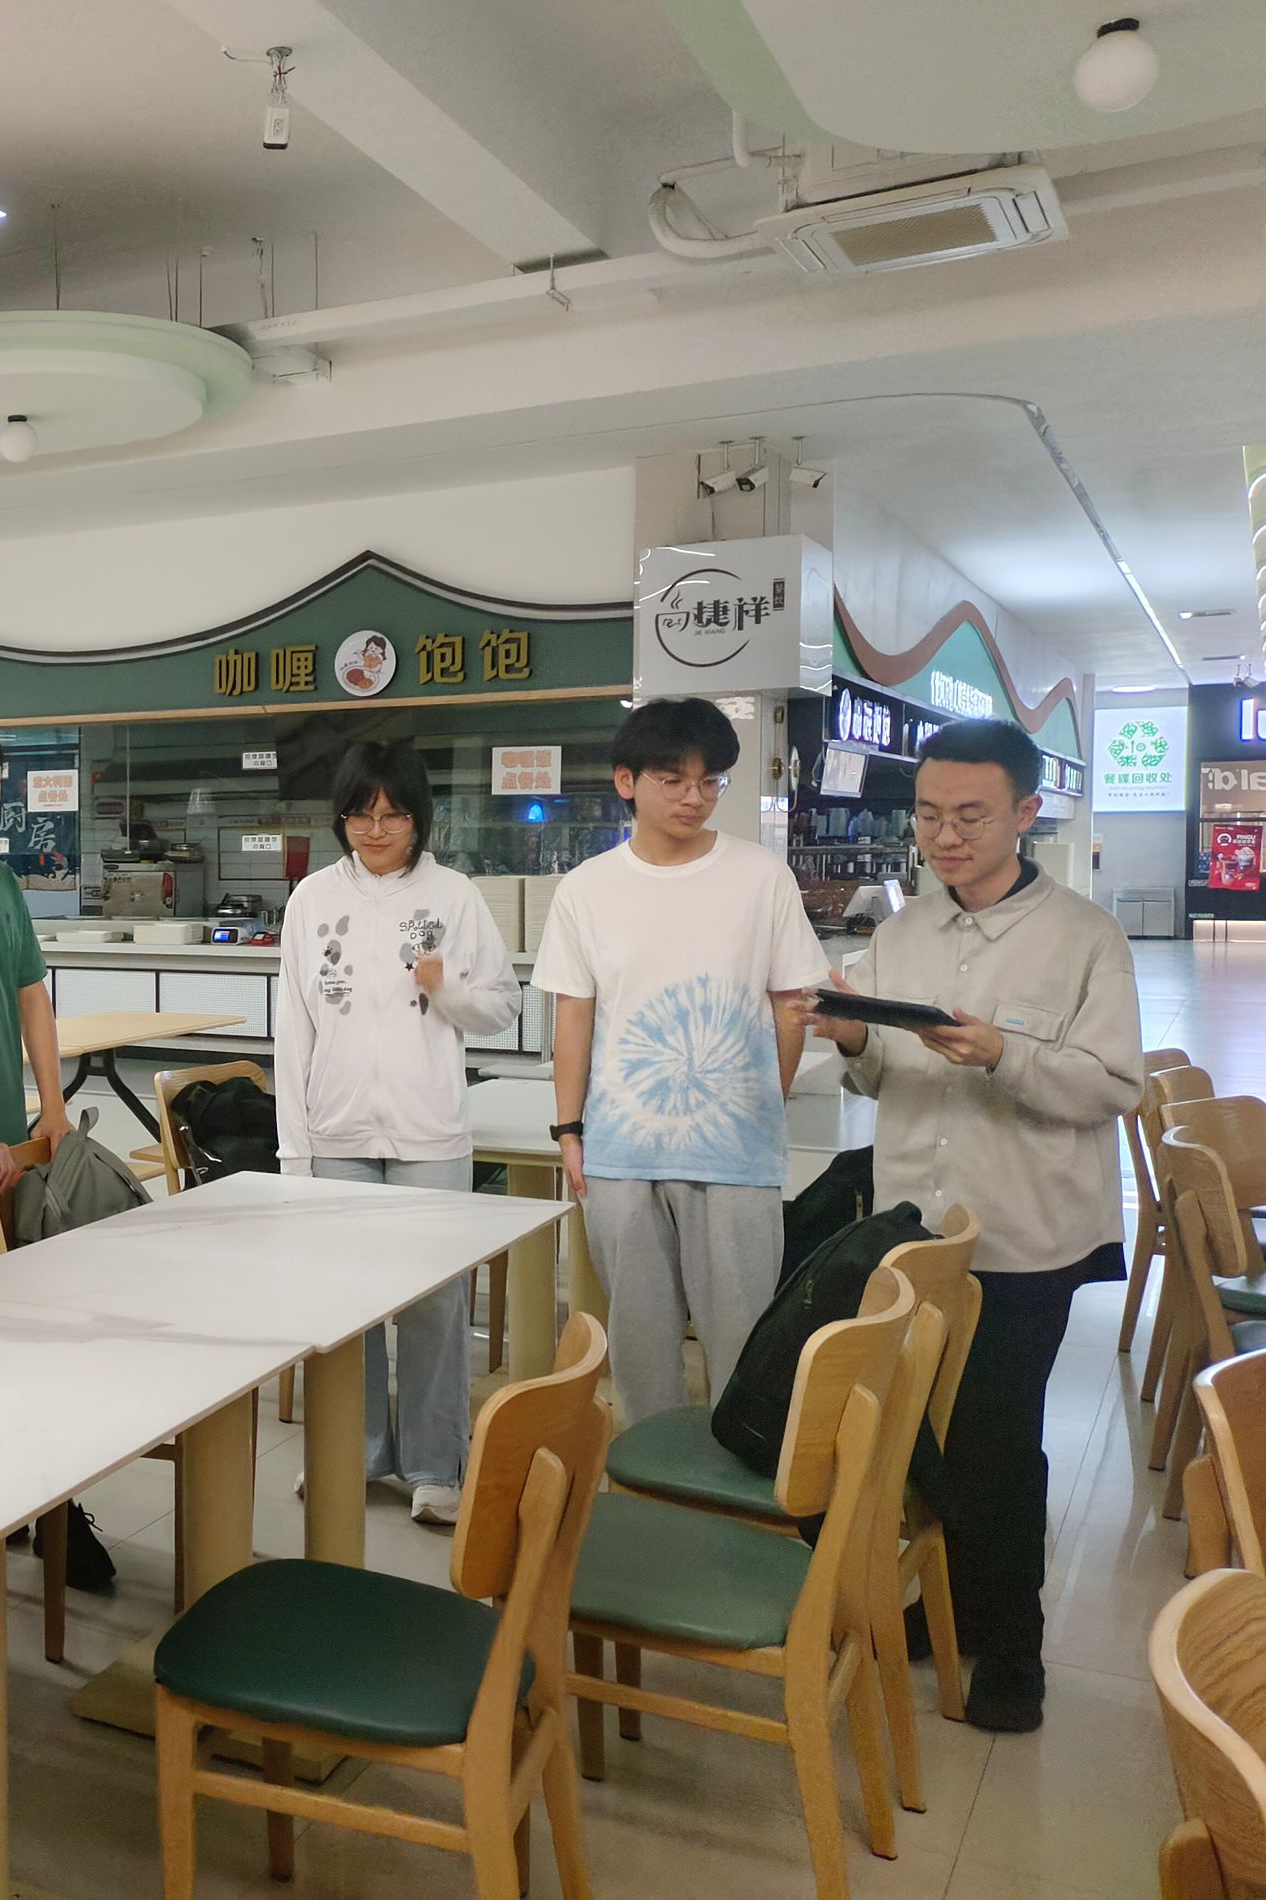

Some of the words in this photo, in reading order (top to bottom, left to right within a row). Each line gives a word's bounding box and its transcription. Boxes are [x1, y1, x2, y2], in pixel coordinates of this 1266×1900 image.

[693, 596, 771, 631] 捷祥
[214, 645, 317, 696] 咖喱
[415, 629, 531, 685] 饱饱
